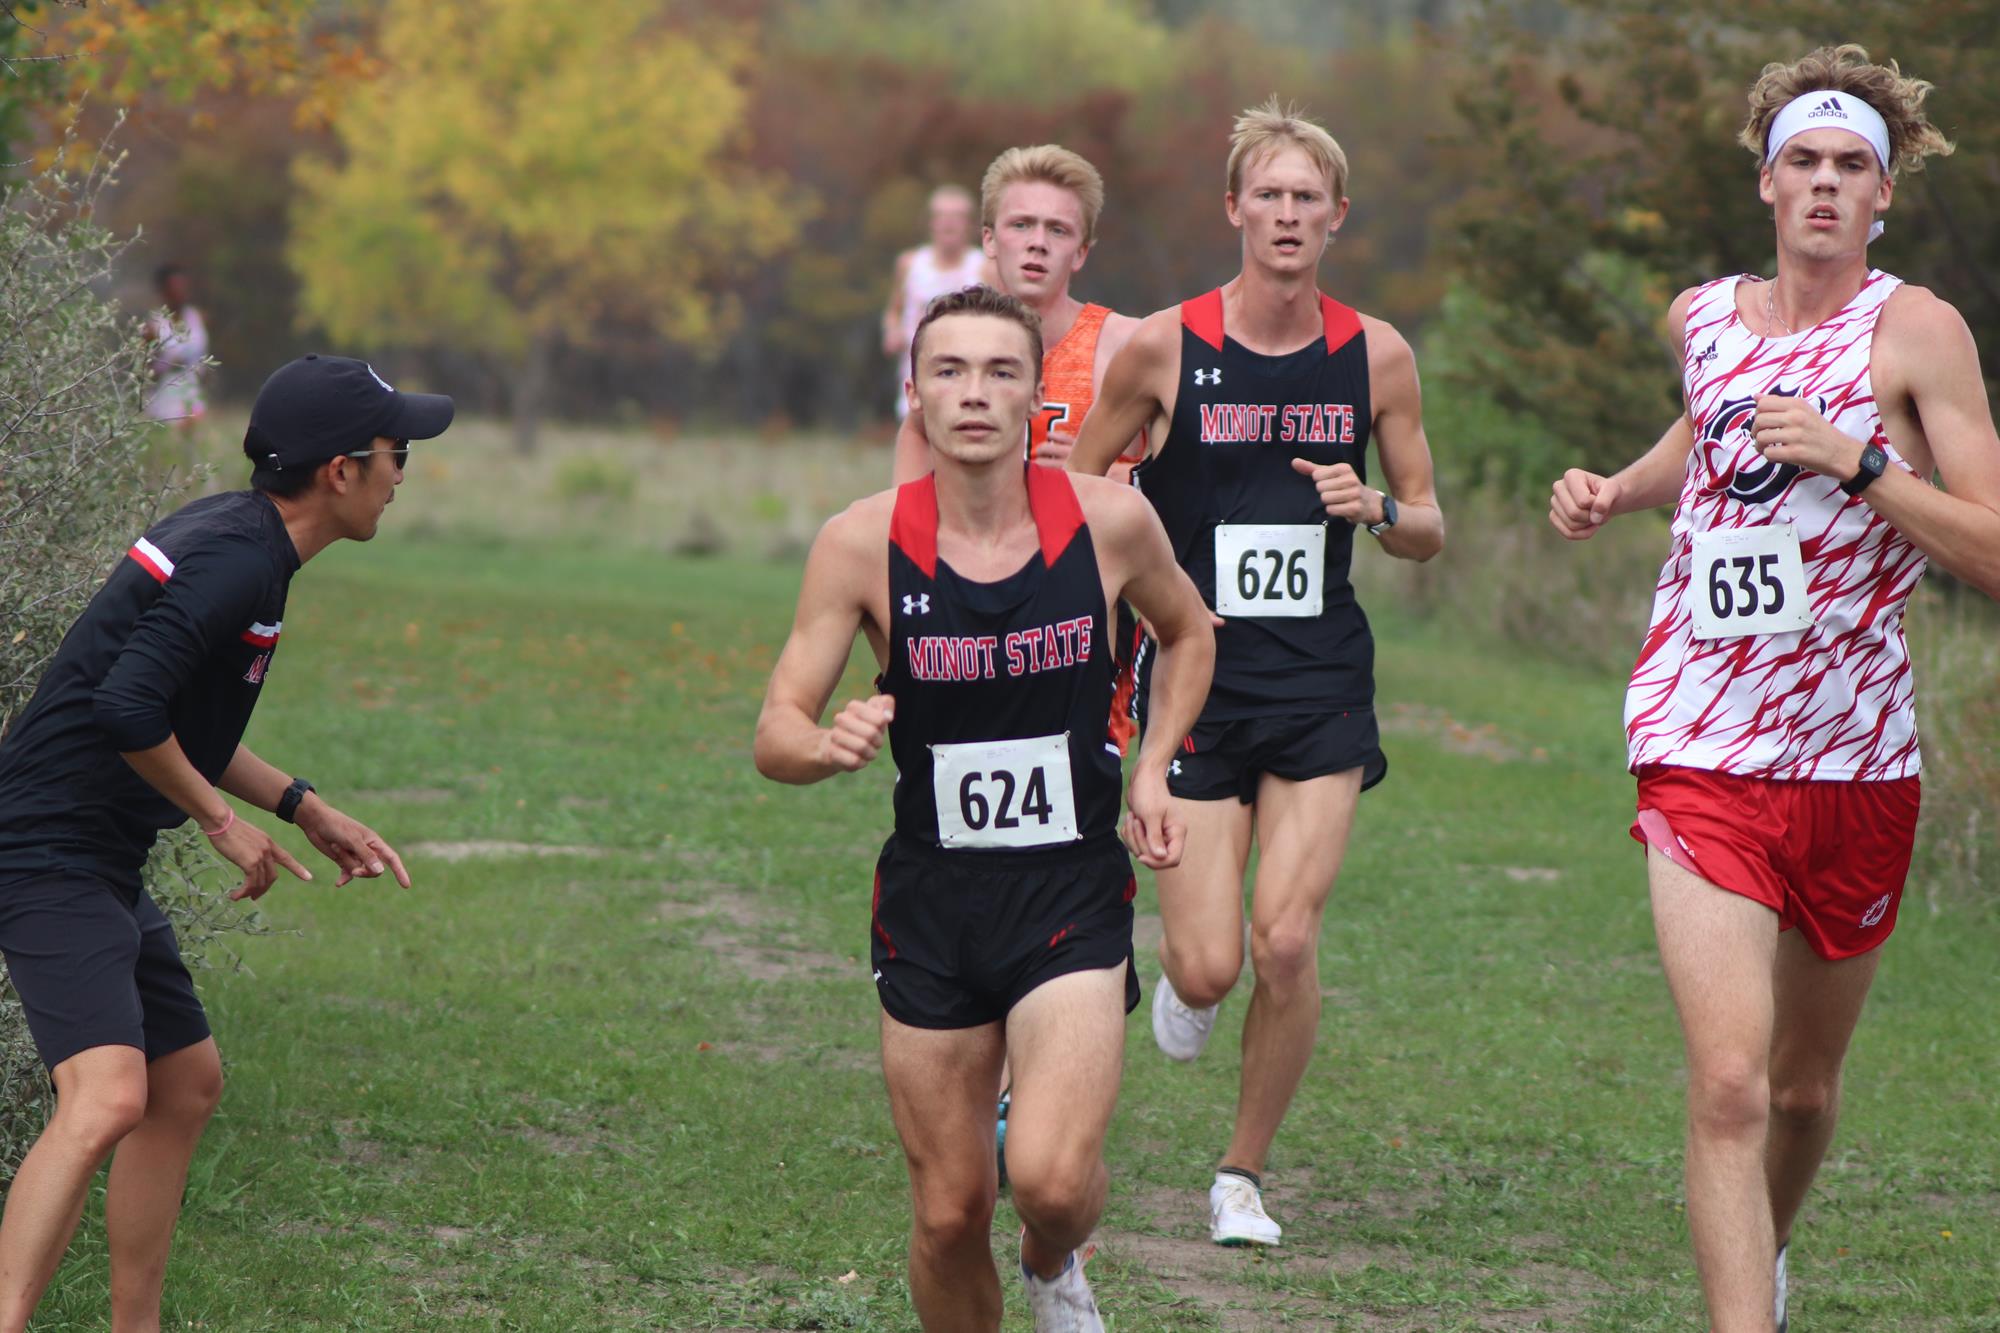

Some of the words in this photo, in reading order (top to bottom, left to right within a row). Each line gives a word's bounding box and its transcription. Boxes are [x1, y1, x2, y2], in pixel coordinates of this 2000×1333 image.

[1808, 109, 1848, 119] adidas
[1200, 404, 1277, 443] MINOT
[1280, 404, 1355, 443] STATE
[1237, 549, 1308, 600] 626
[1709, 554, 1785, 619] 635
[907, 636, 998, 681] MINOT
[1005, 615, 1093, 676] STATE
[959, 766, 1053, 831] 624
